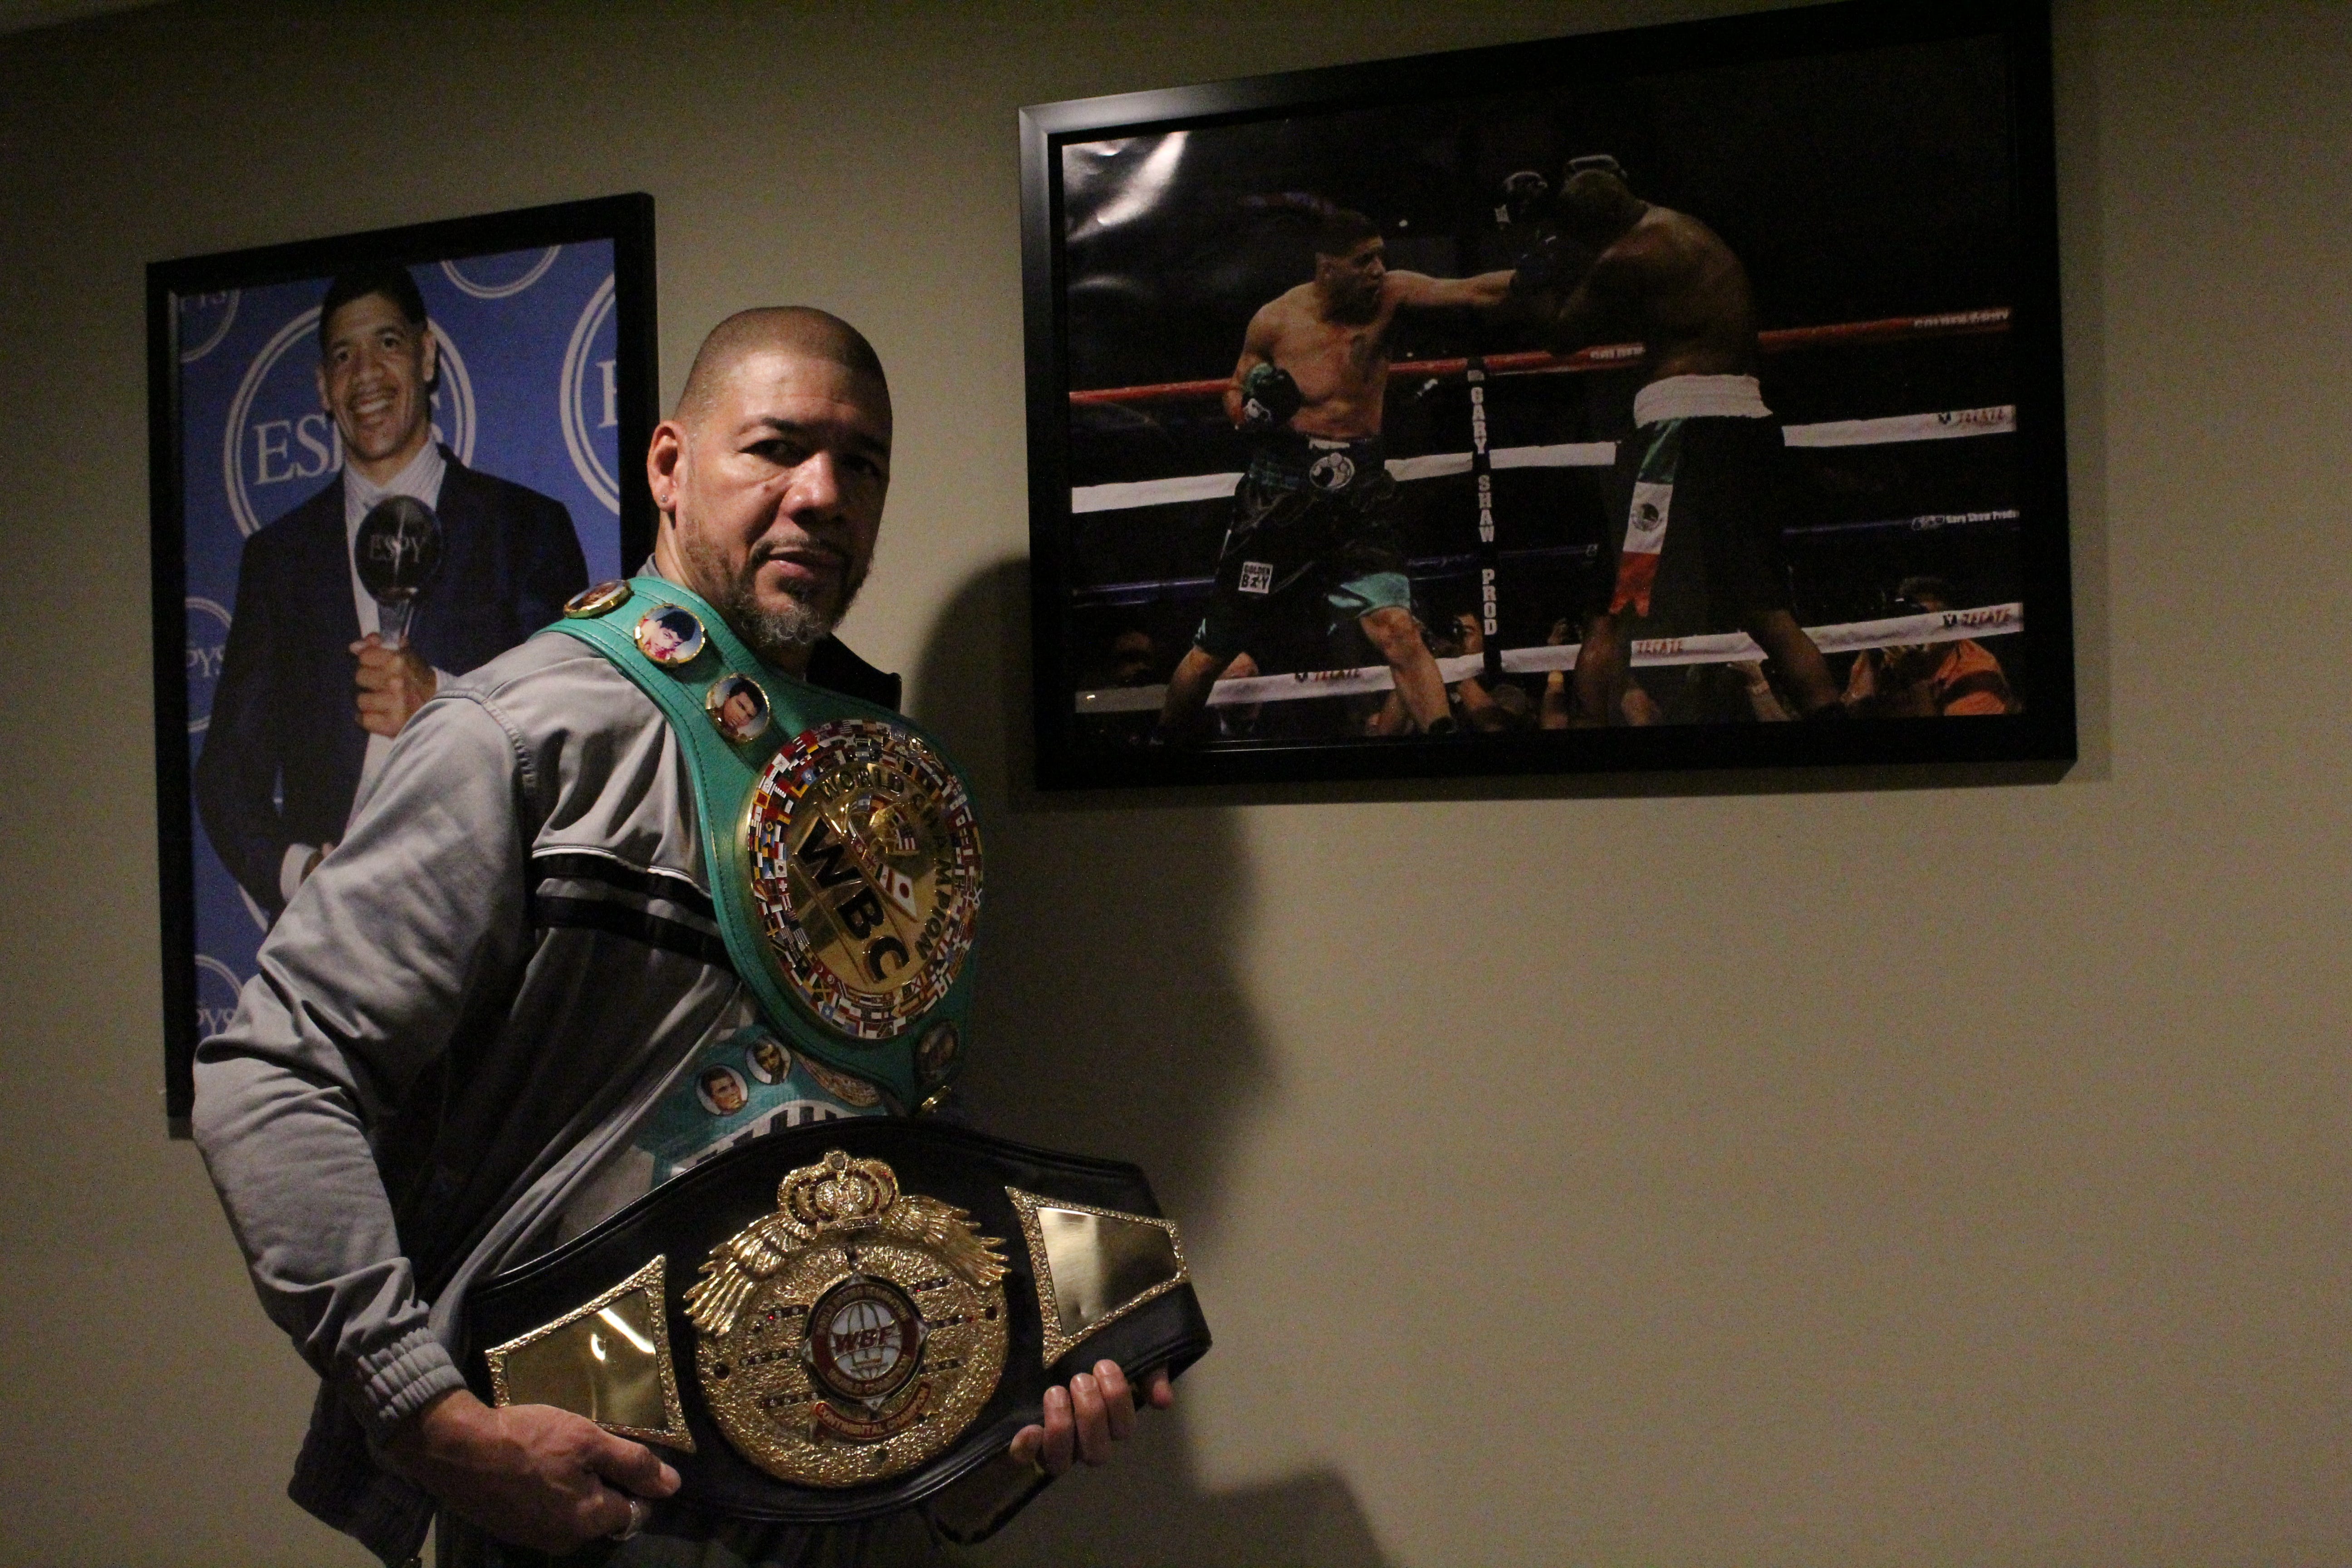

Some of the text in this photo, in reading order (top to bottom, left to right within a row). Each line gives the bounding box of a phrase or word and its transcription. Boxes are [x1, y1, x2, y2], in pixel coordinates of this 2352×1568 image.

[1478, 474, 1495, 543] SHAW
[1482, 568, 1498, 636] PROD
[818, 767, 954, 960] WORLD CHAMPION
[796, 816, 910, 984] WBC
[831, 1318, 898, 1354] WBF
